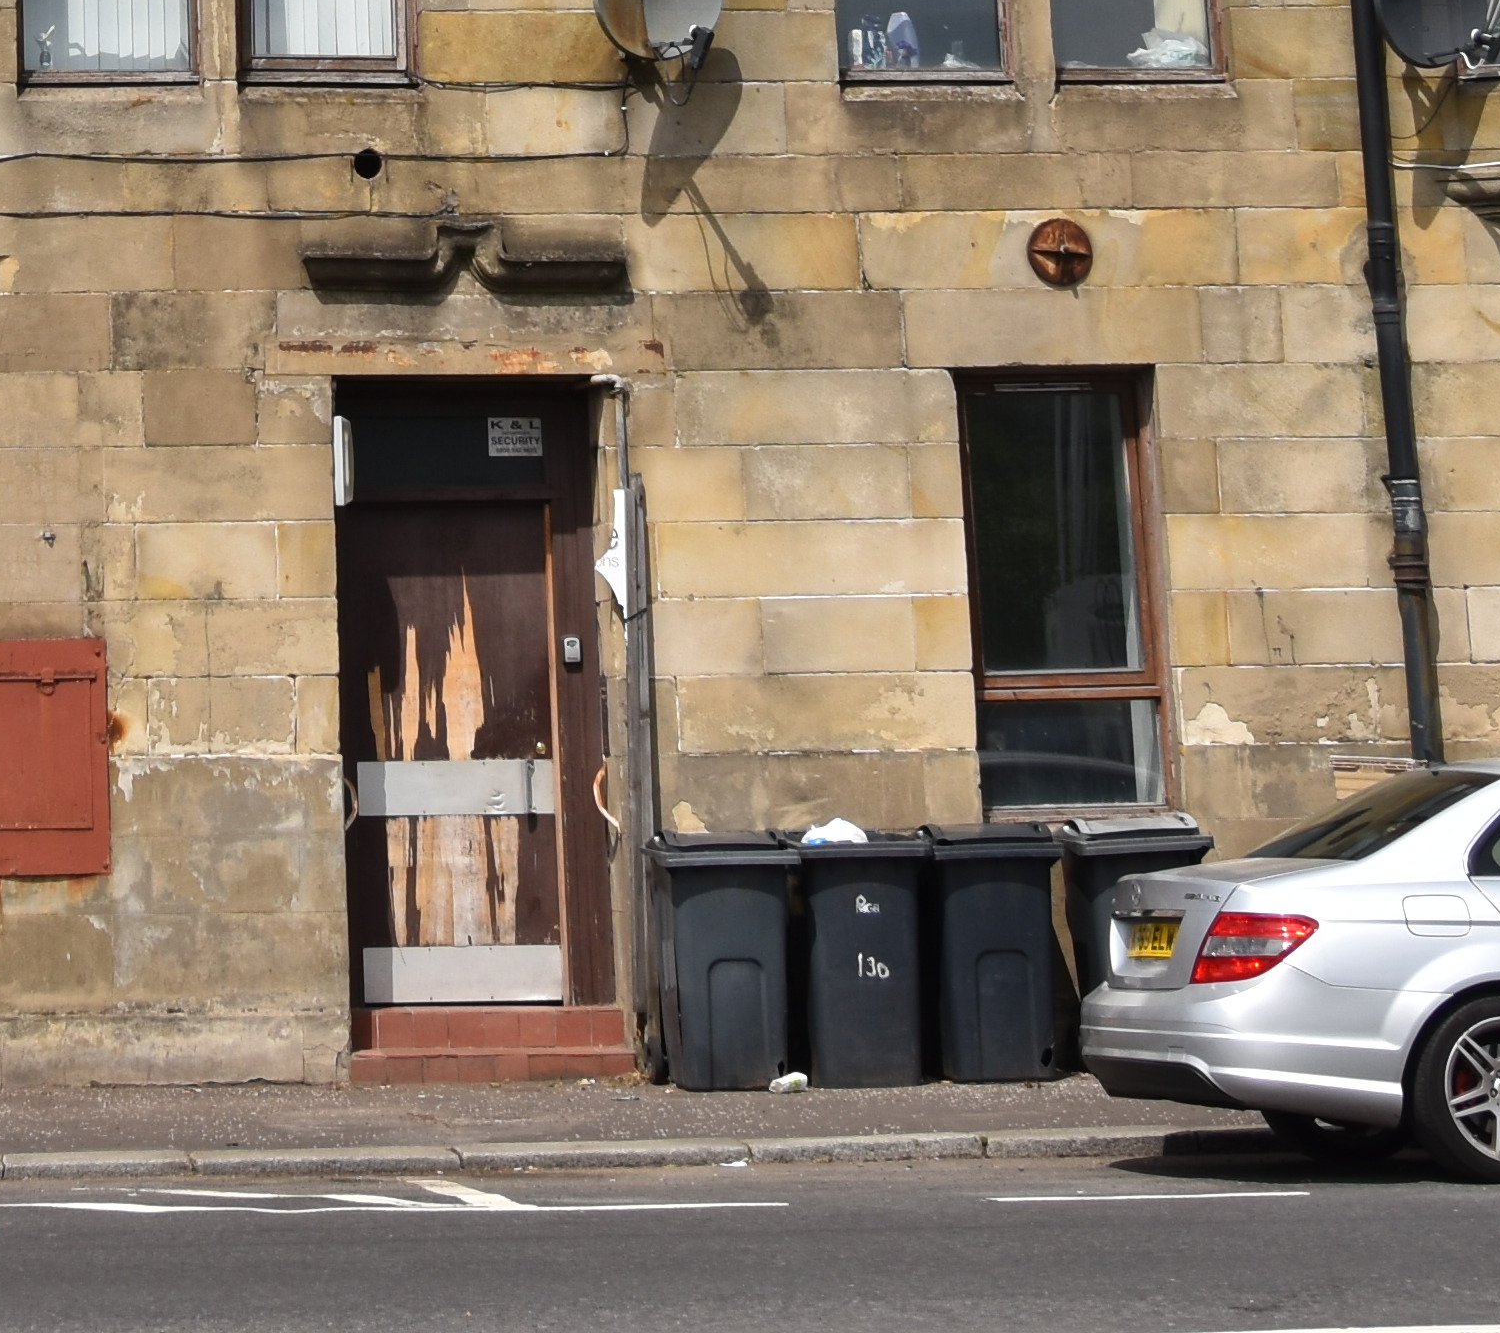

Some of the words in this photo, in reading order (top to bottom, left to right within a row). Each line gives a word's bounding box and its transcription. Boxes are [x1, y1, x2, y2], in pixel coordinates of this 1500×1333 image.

[490, 420, 504, 430] K
[510, 420, 522, 430] &
[529, 420, 540, 430] L
[490, 436, 540, 445] SECURITY
[857, 952, 890, 979] 130
